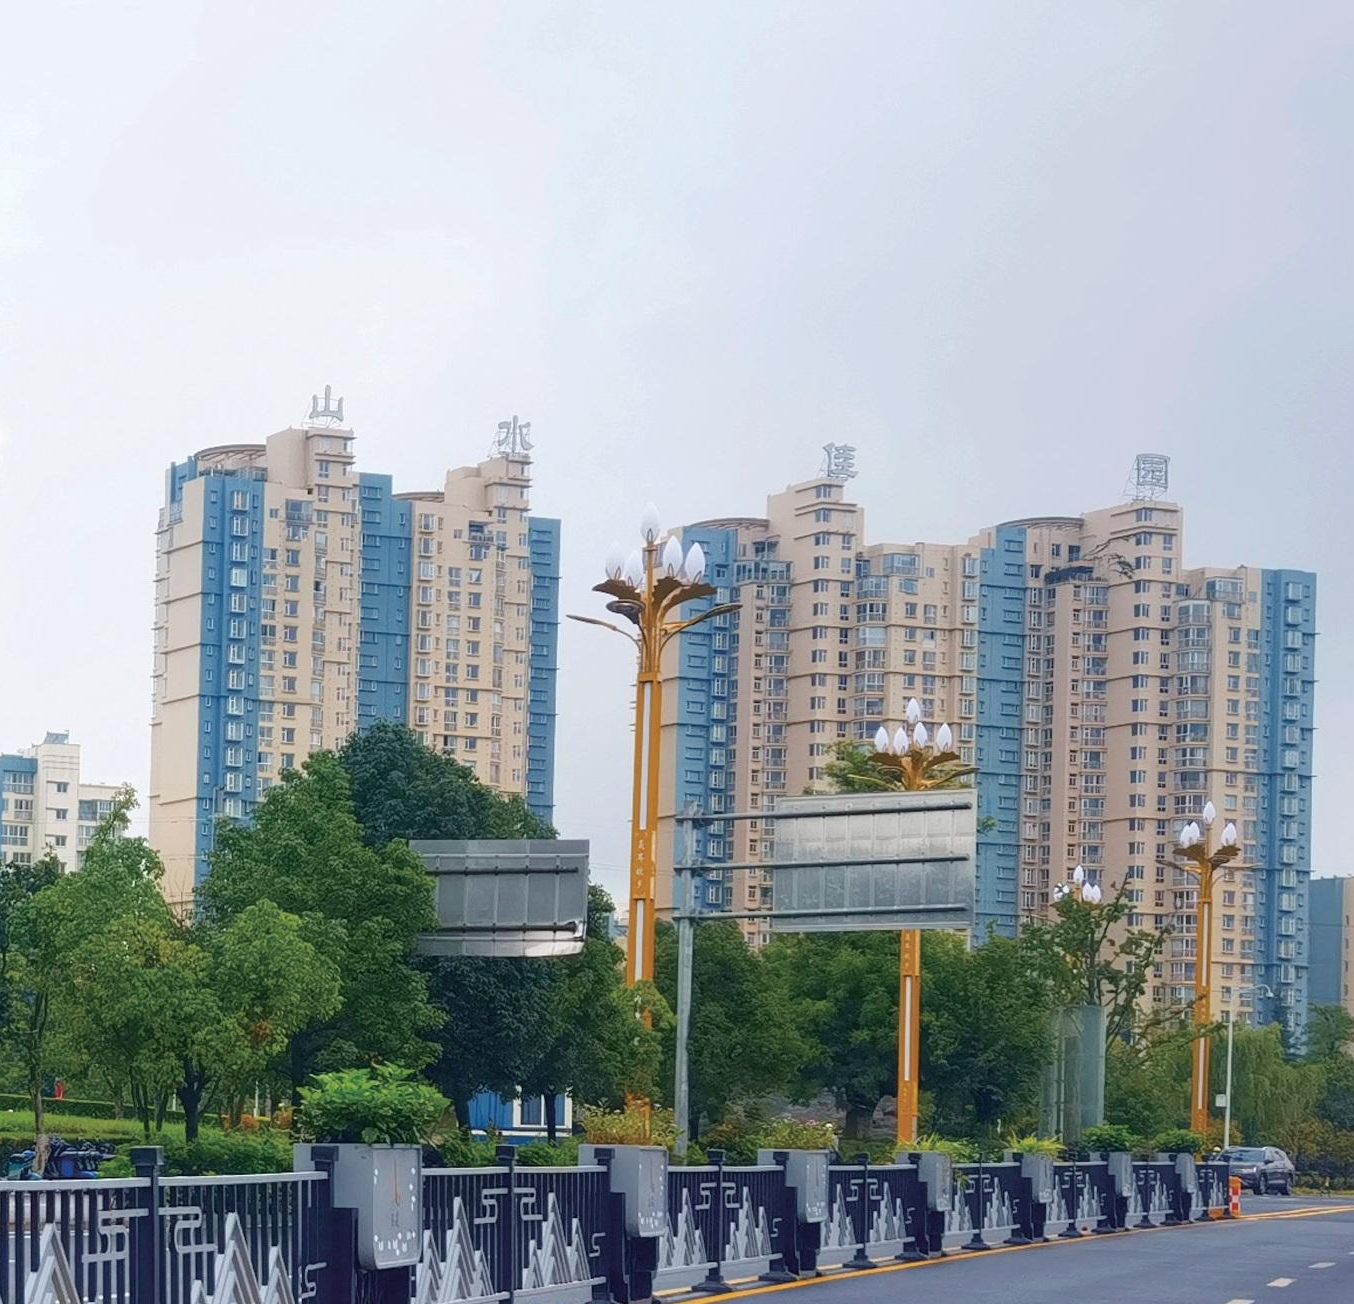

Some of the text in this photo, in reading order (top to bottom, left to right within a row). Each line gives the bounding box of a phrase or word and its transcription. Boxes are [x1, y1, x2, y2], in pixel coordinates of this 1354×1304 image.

[309, 384, 1170, 488] 山 水 佳 园
